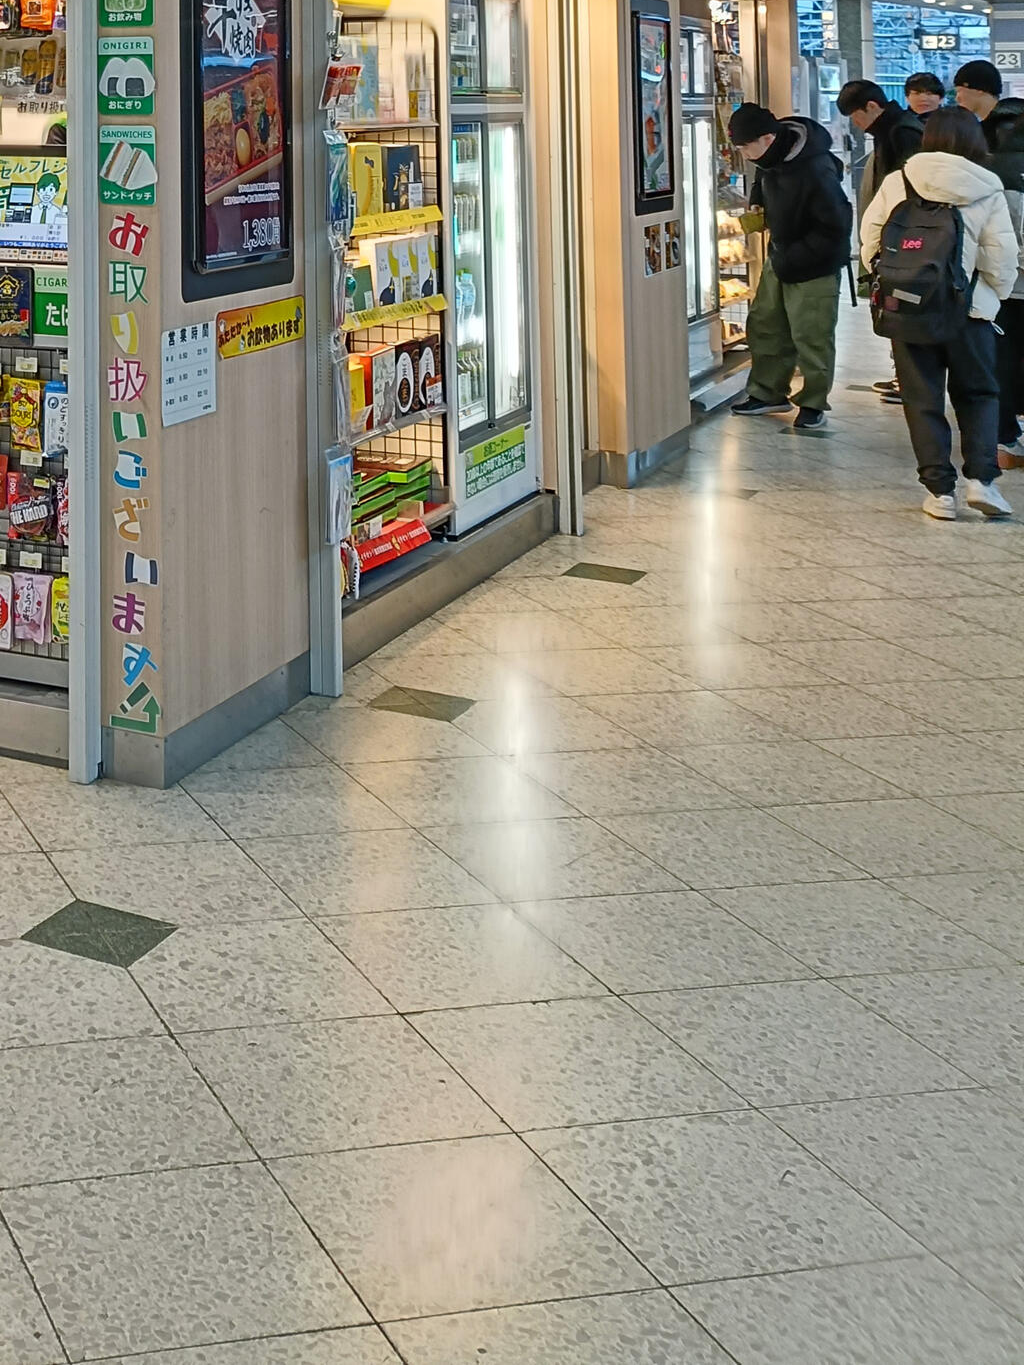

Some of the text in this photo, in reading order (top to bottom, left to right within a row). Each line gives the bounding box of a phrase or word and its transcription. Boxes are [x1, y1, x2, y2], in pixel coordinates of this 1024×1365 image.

[108, 12, 142, 22] お飲み物
[102, 41, 148, 50] ONIGIRI
[938, 35, 956, 48] 23
[996, 54, 1018, 66] 23
[108, 100, 142, 110] おにぎり
[101, 129, 153, 139] SANDWICHES
[0, 159, 67, 180] セルフレジ
[103, 190, 152, 201] サンドイッチ
[902, 239, 923, 249] Lee
